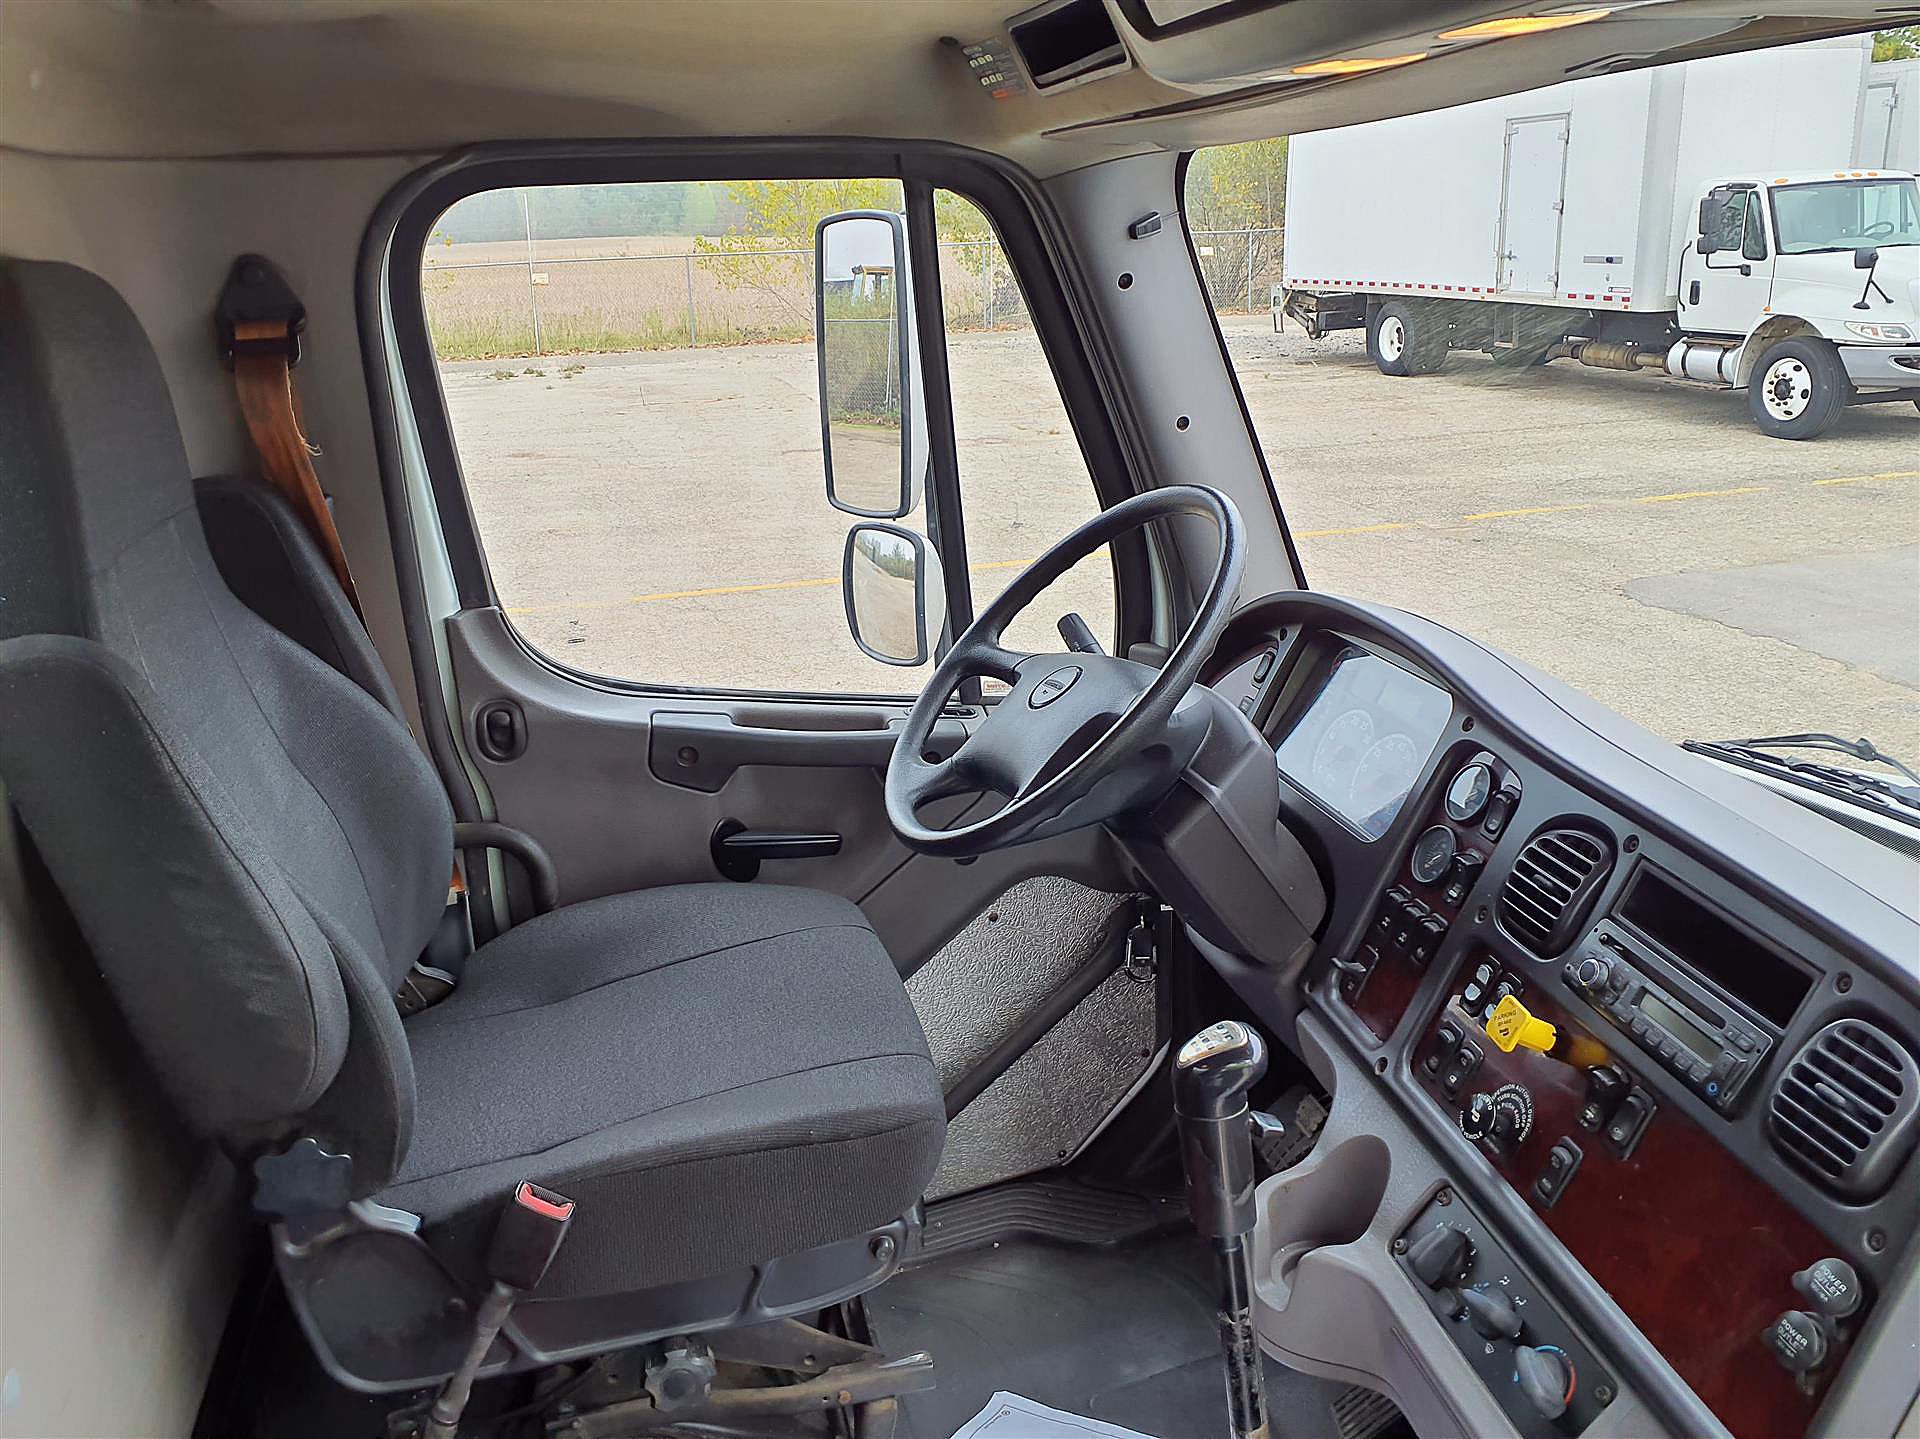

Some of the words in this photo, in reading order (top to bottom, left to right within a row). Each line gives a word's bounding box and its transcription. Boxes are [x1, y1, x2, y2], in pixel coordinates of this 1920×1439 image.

[1494, 1010, 1517, 1022] PARKING
[1517, 1108, 1534, 1142] OVERRIDE
[1813, 1270, 1842, 1298] OUTLET
[1820, 1264, 1848, 1293] POWER
[1777, 1325, 1804, 1353] OUTLET
[1781, 1318, 1808, 1347] POWER
